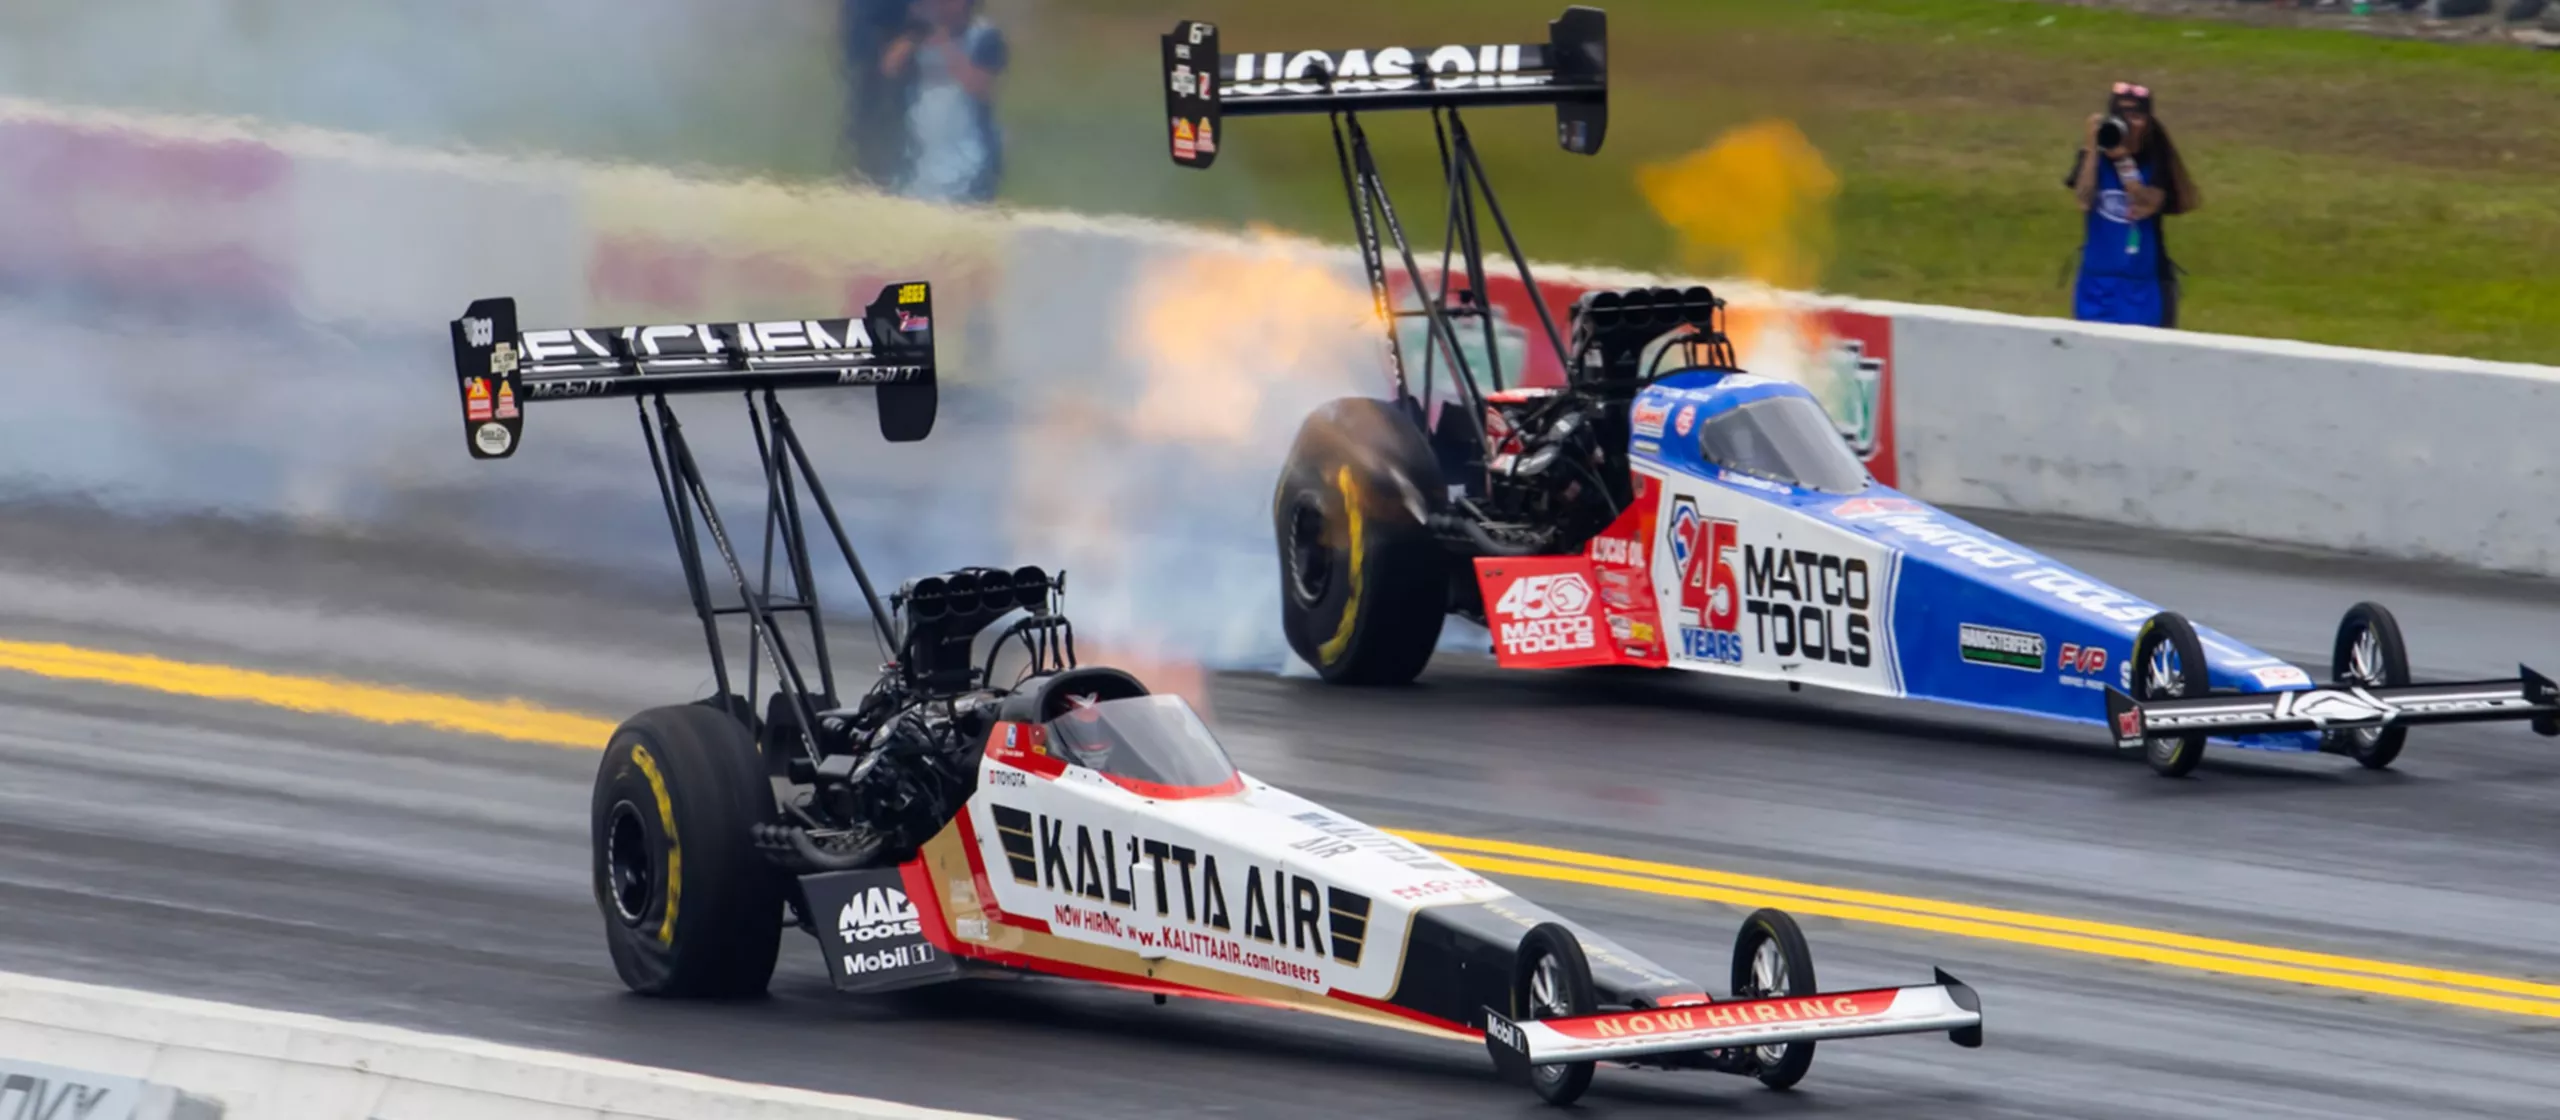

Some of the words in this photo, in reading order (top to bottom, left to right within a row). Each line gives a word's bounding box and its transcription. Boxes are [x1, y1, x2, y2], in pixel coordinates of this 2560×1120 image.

[1427, 44, 1552, 92] OIL
[517, 316, 875, 374] EVCHEM
[1679, 514, 1740, 632] 45
[1744, 543, 1870, 610] MATCO
[1501, 615, 1593, 645] MATCO
[1505, 631, 1595, 656] TOOLS
[1679, 625, 1743, 666] YEARS
[1746, 599, 1871, 668] TOOLS
[2059, 642, 2107, 675] FVP
[995, 769, 1027, 788] TOYOTA
[1289, 836, 1357, 859] AIR
[839, 887, 920, 931] MAC
[1055, 903, 1081, 928] NOW
[1084, 909, 1123, 938] HIRING
[1243, 864, 1325, 959] AIR
[839, 920, 921, 943] TOOLS
[843, 947, 909, 975] Mobil
[1487, 1013, 1514, 1048] Mobil
[1594, 1011, 1694, 1037] NOW
[1706, 998, 1860, 1026] HIRING
